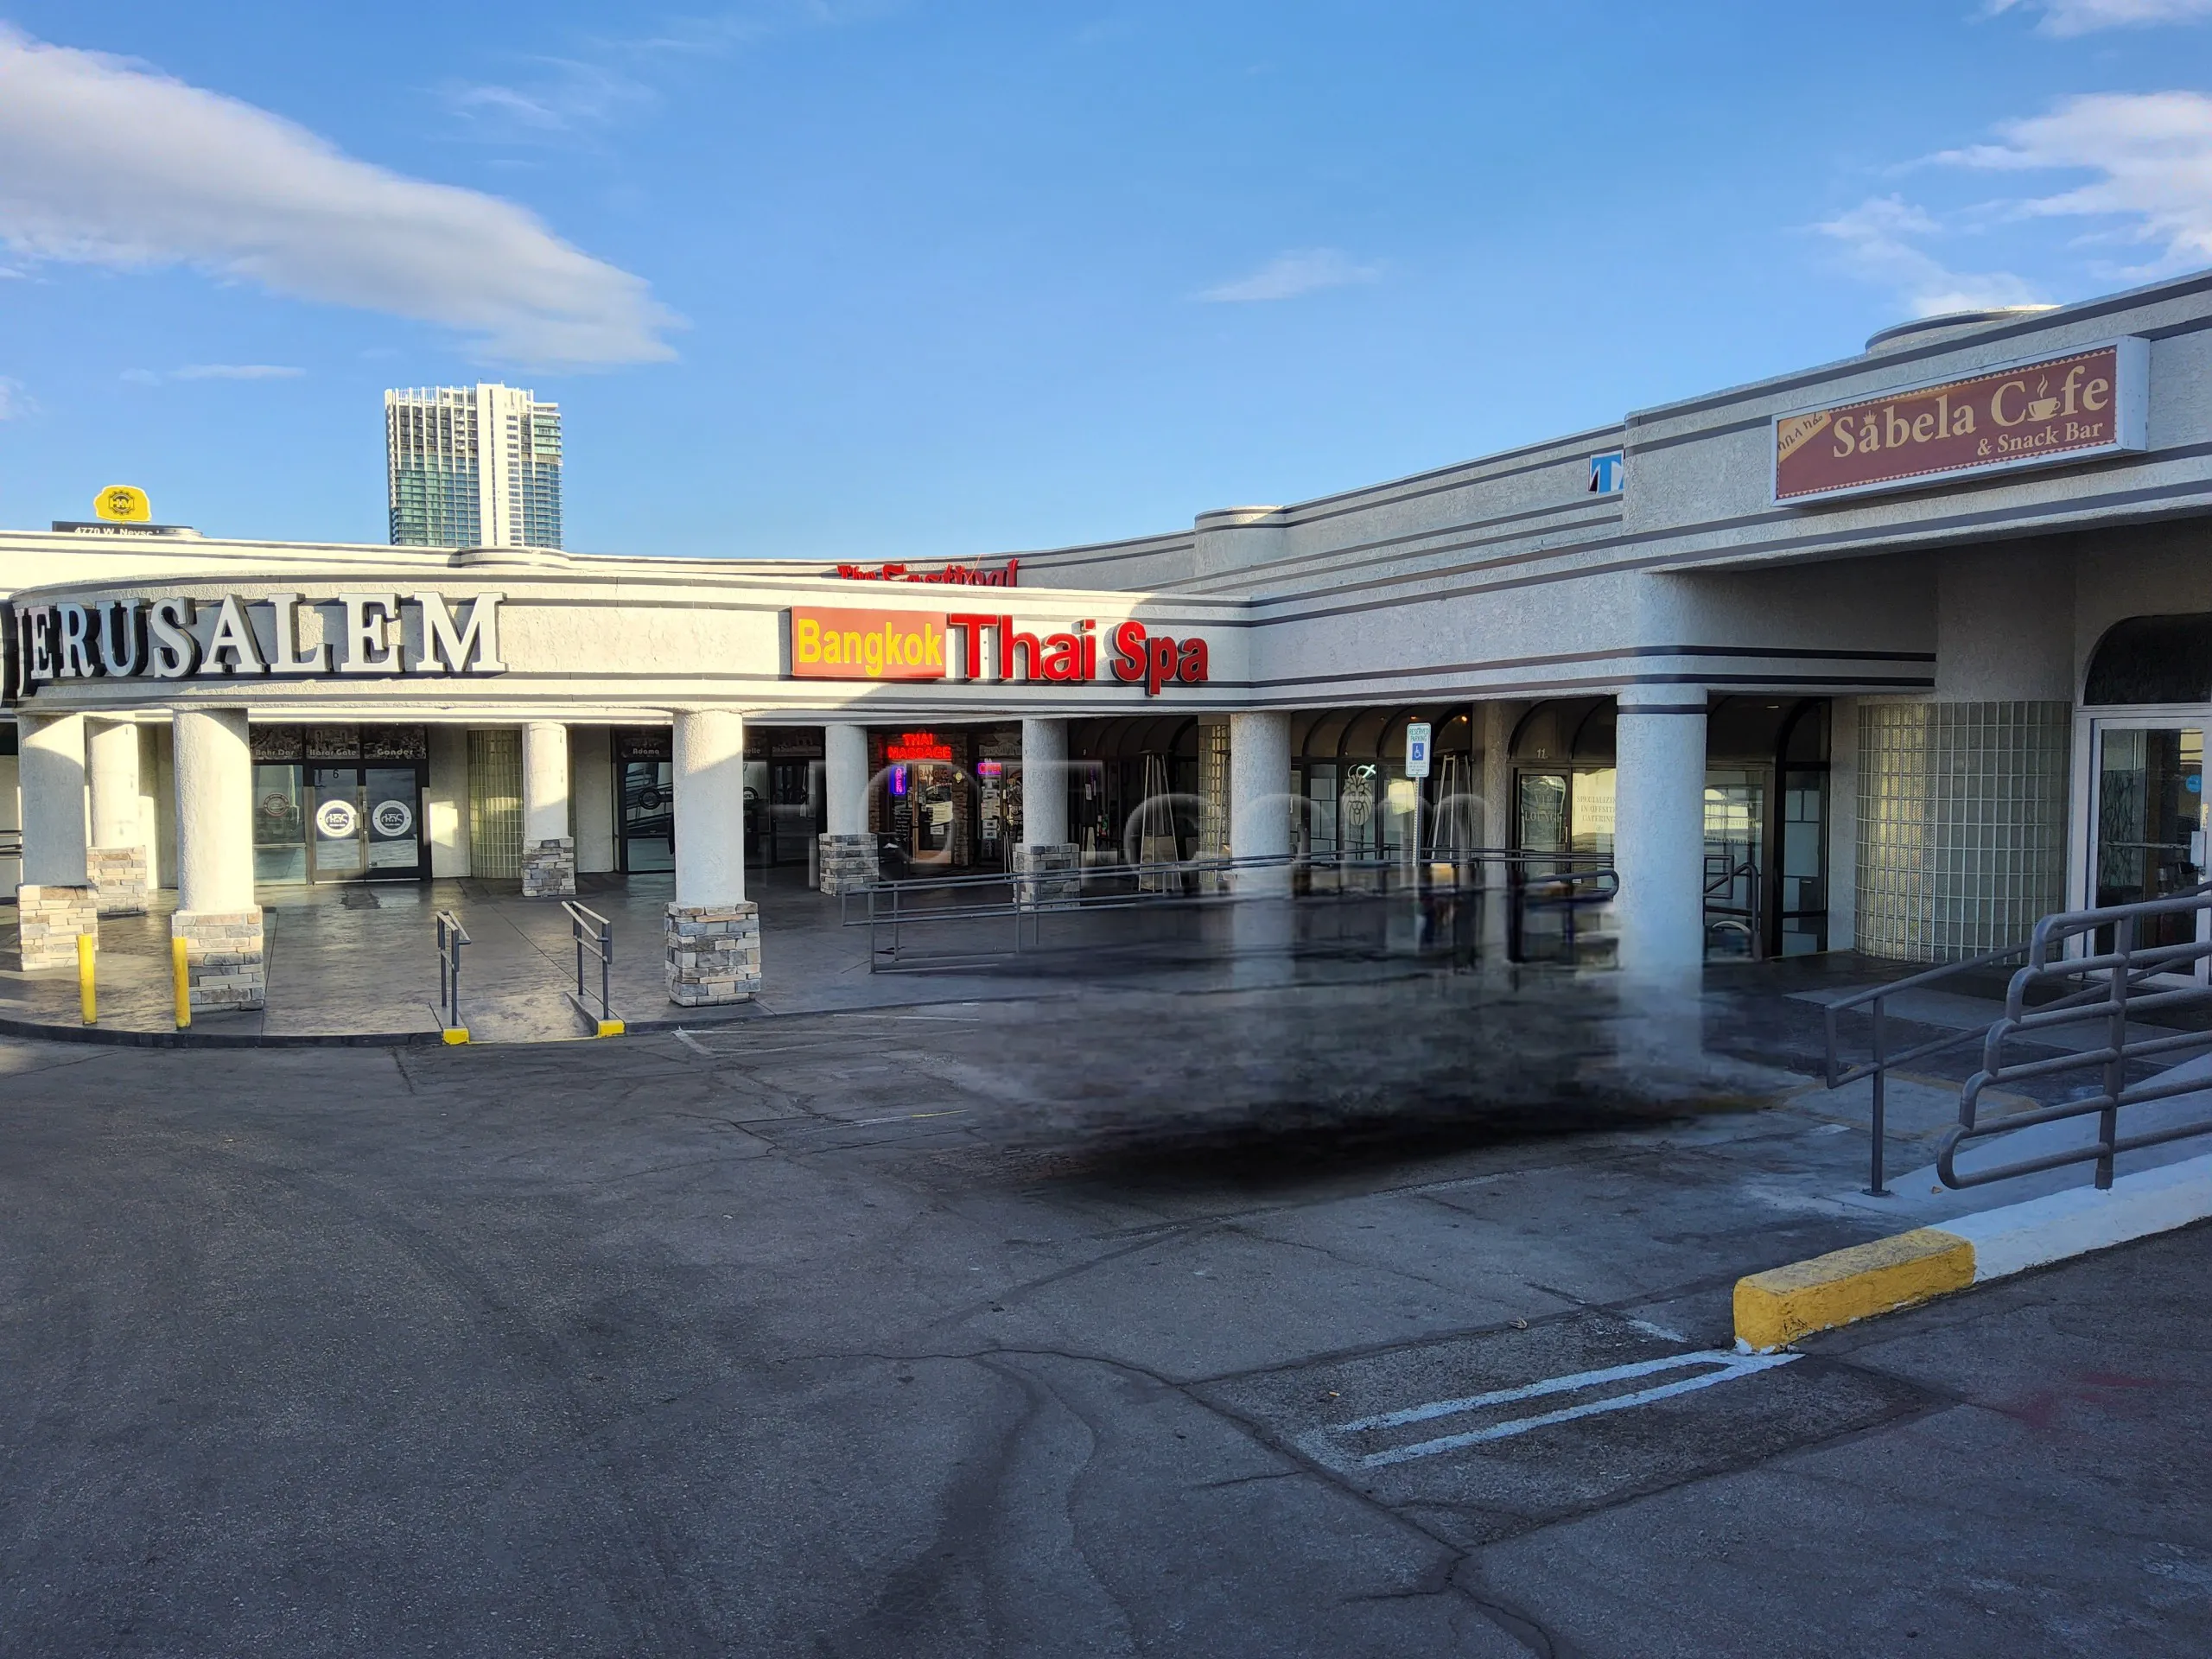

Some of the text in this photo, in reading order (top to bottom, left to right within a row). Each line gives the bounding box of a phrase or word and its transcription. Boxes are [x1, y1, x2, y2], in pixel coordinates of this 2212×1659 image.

[1832, 394, 1976, 459] Sabela
[1977, 420, 2103, 456] & Snack Bar
[15, 592, 508, 698] JERUSALEM
[797, 613, 1210, 696] Bangkok Thai Spa
[902, 733, 934, 746] THAI
[377, 747, 413, 756] Gonder
[887, 746, 951, 759] MASSAGE
[333, 768, 340, 779] 6
[979, 763, 1001, 773] OPEN
